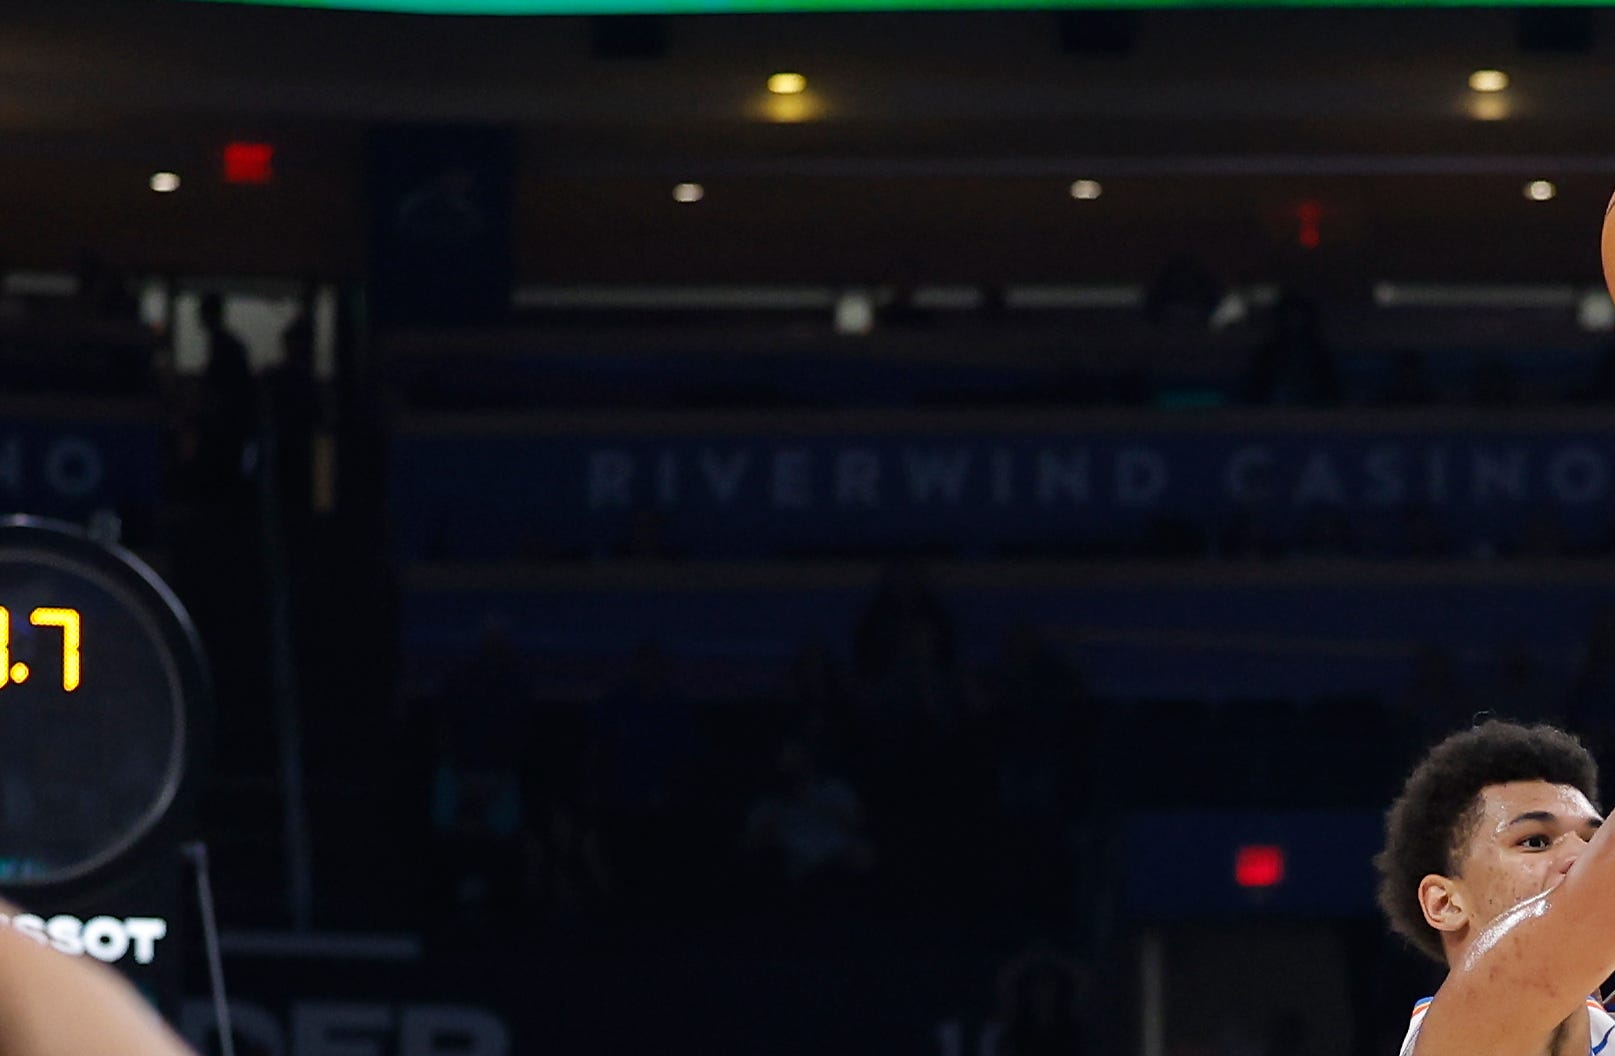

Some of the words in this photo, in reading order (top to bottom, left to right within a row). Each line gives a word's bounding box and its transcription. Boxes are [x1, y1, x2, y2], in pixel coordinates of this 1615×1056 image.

[588, 446, 1169, 508] RIVERWIND
[1223, 444, 1607, 504] CASINO
[0, 605, 81, 692] .7
[0, 912, 167, 964] SSOT
